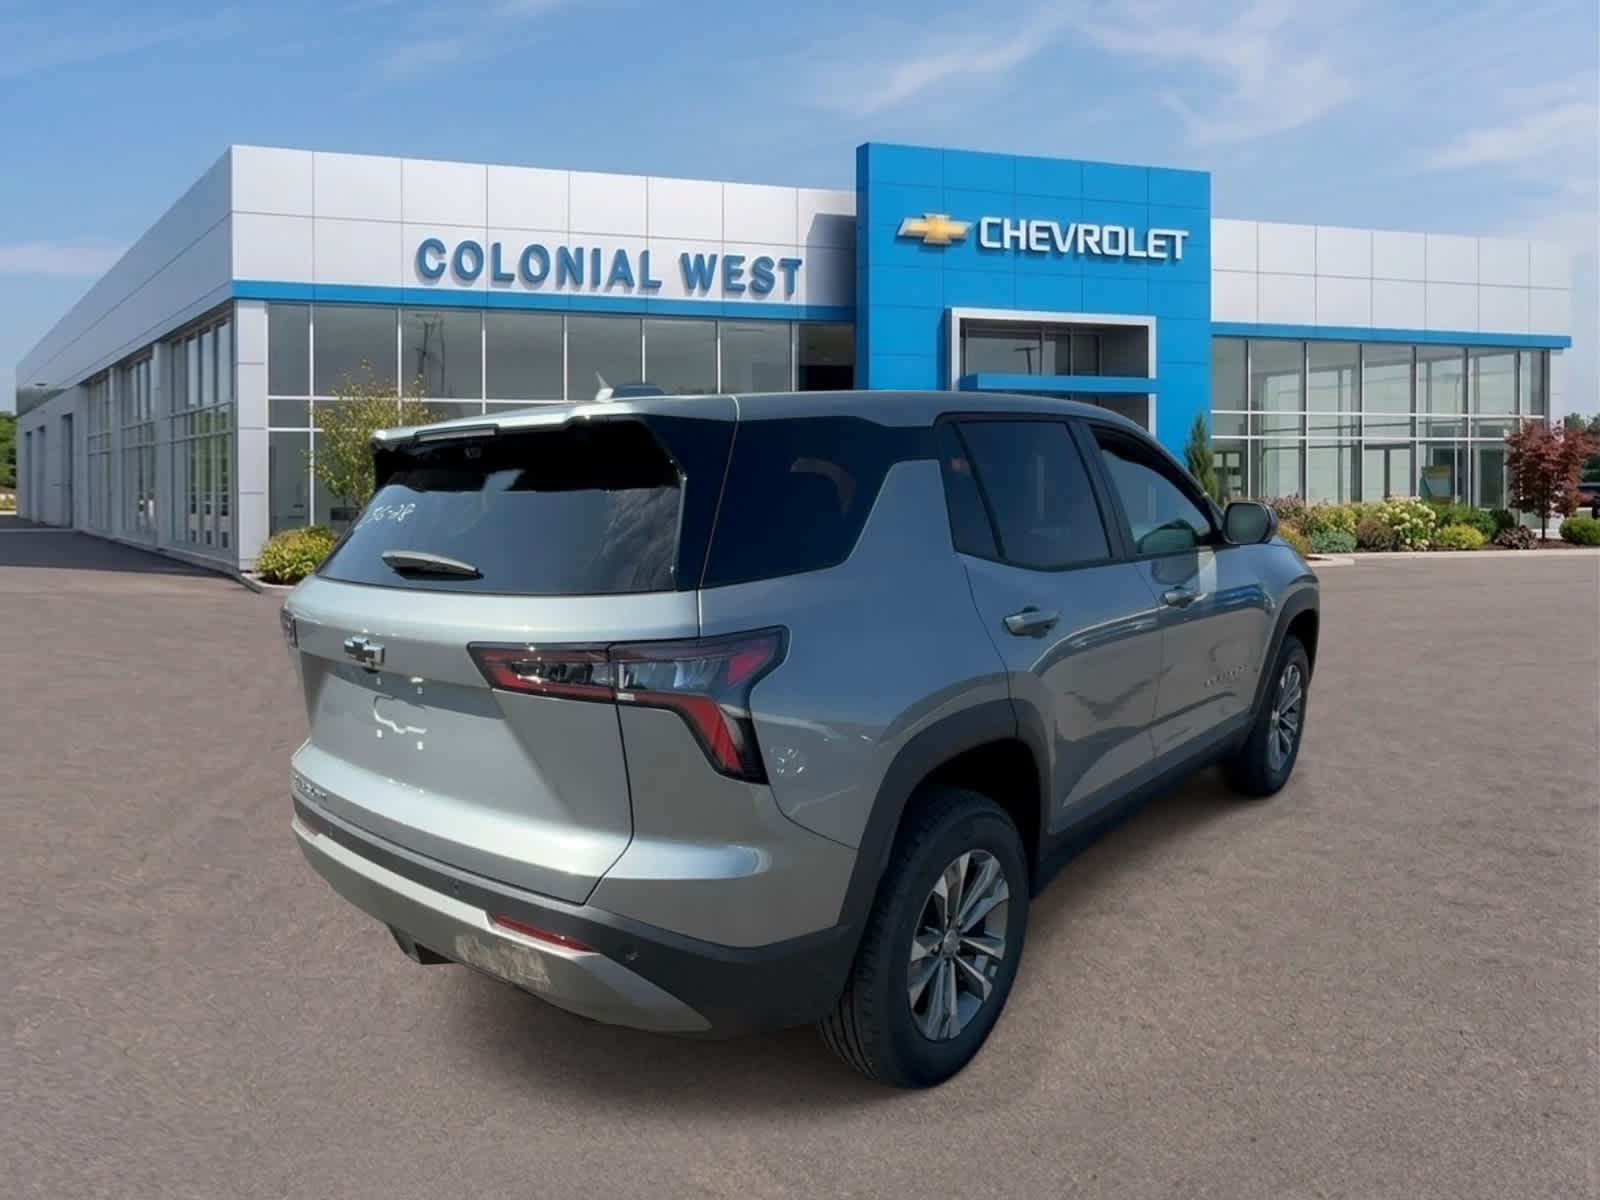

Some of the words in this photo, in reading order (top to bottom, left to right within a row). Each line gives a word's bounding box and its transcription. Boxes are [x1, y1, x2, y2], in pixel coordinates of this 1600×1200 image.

[979, 216, 1189, 260] CHEVROLET
[416, 237, 662, 289] COLONIAL
[680, 252, 804, 295] WEST
